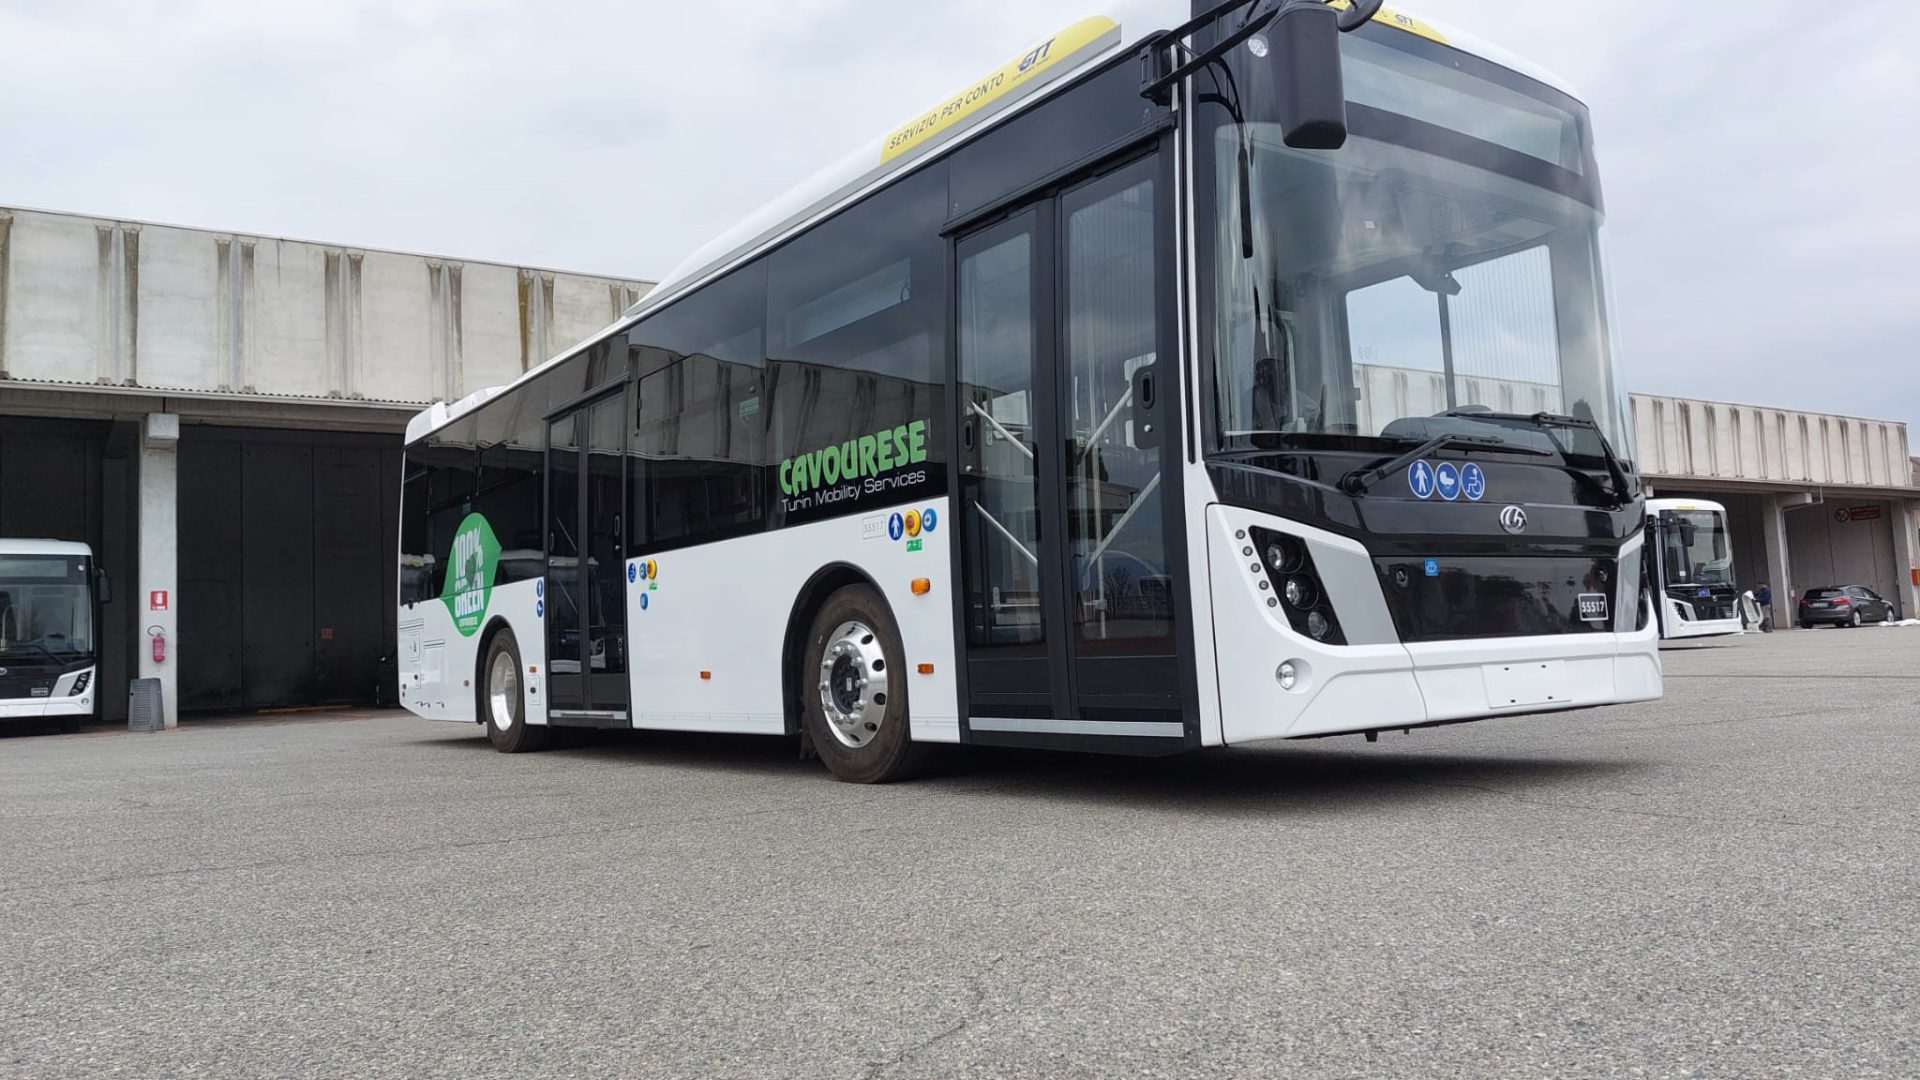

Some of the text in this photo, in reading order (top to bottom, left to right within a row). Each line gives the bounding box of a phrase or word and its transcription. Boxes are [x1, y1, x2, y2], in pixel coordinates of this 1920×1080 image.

[890, 113, 937, 150] SERVIZIO
[940, 98, 963, 121] PER
[965, 73, 1004, 105] CONTO
[1018, 37, 1056, 71] GTT
[779, 419, 927, 497] CAVOURESE
[782, 470, 926, 512] Turin Mobility Services
[1581, 601, 1605, 612] 55517
